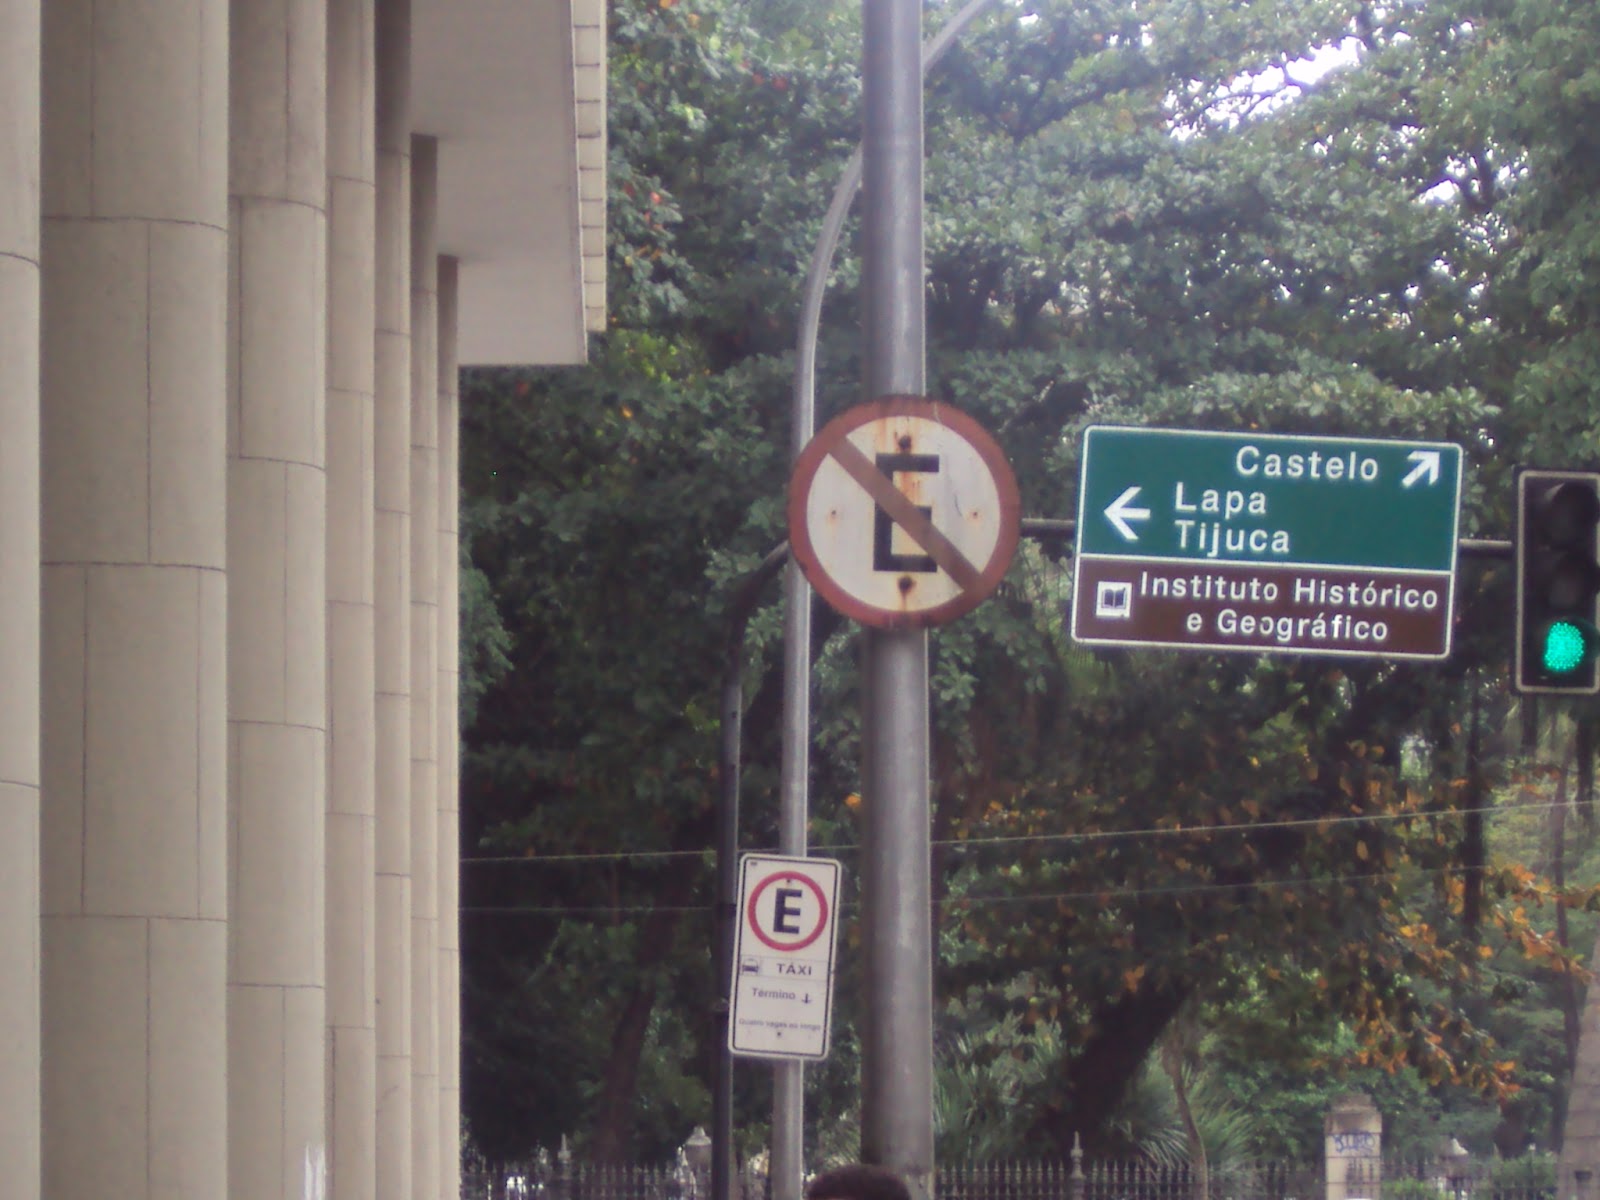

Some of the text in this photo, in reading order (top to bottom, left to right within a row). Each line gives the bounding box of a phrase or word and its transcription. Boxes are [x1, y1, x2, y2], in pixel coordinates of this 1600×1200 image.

[1235, 445, 1379, 481] Castelo
[1174, 481, 1267, 519] Lapa
[1174, 518, 1291, 557] Tijuca
[1140, 570, 1438, 609] Instituto Histórico
[1186, 608, 1388, 642] e Geográfico
[773, 887, 802, 934] E
